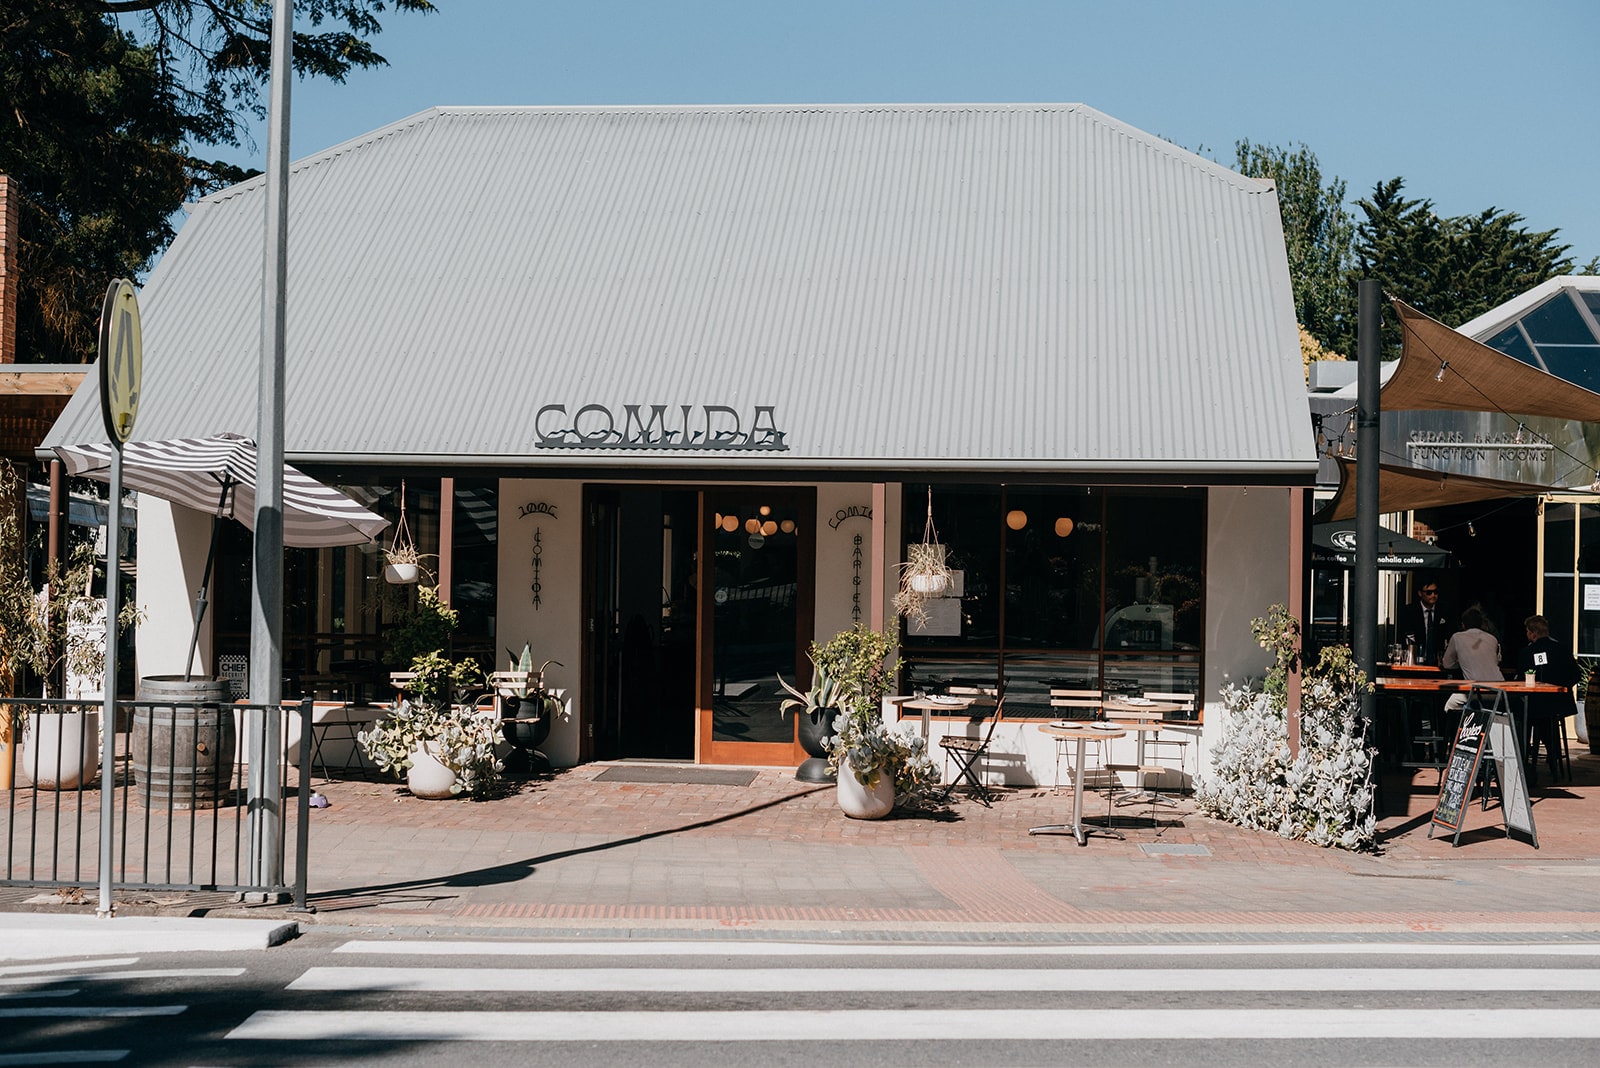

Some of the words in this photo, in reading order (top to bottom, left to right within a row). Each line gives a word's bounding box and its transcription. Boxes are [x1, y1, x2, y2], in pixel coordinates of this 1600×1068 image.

[535, 404, 790, 449] COMIDA
[1413, 446, 1485, 461] FUNCTION
[1498, 448, 1548, 462] ROOMS
[1403, 555, 1425, 564] coffee
[221, 663, 246, 672] CHIEF
